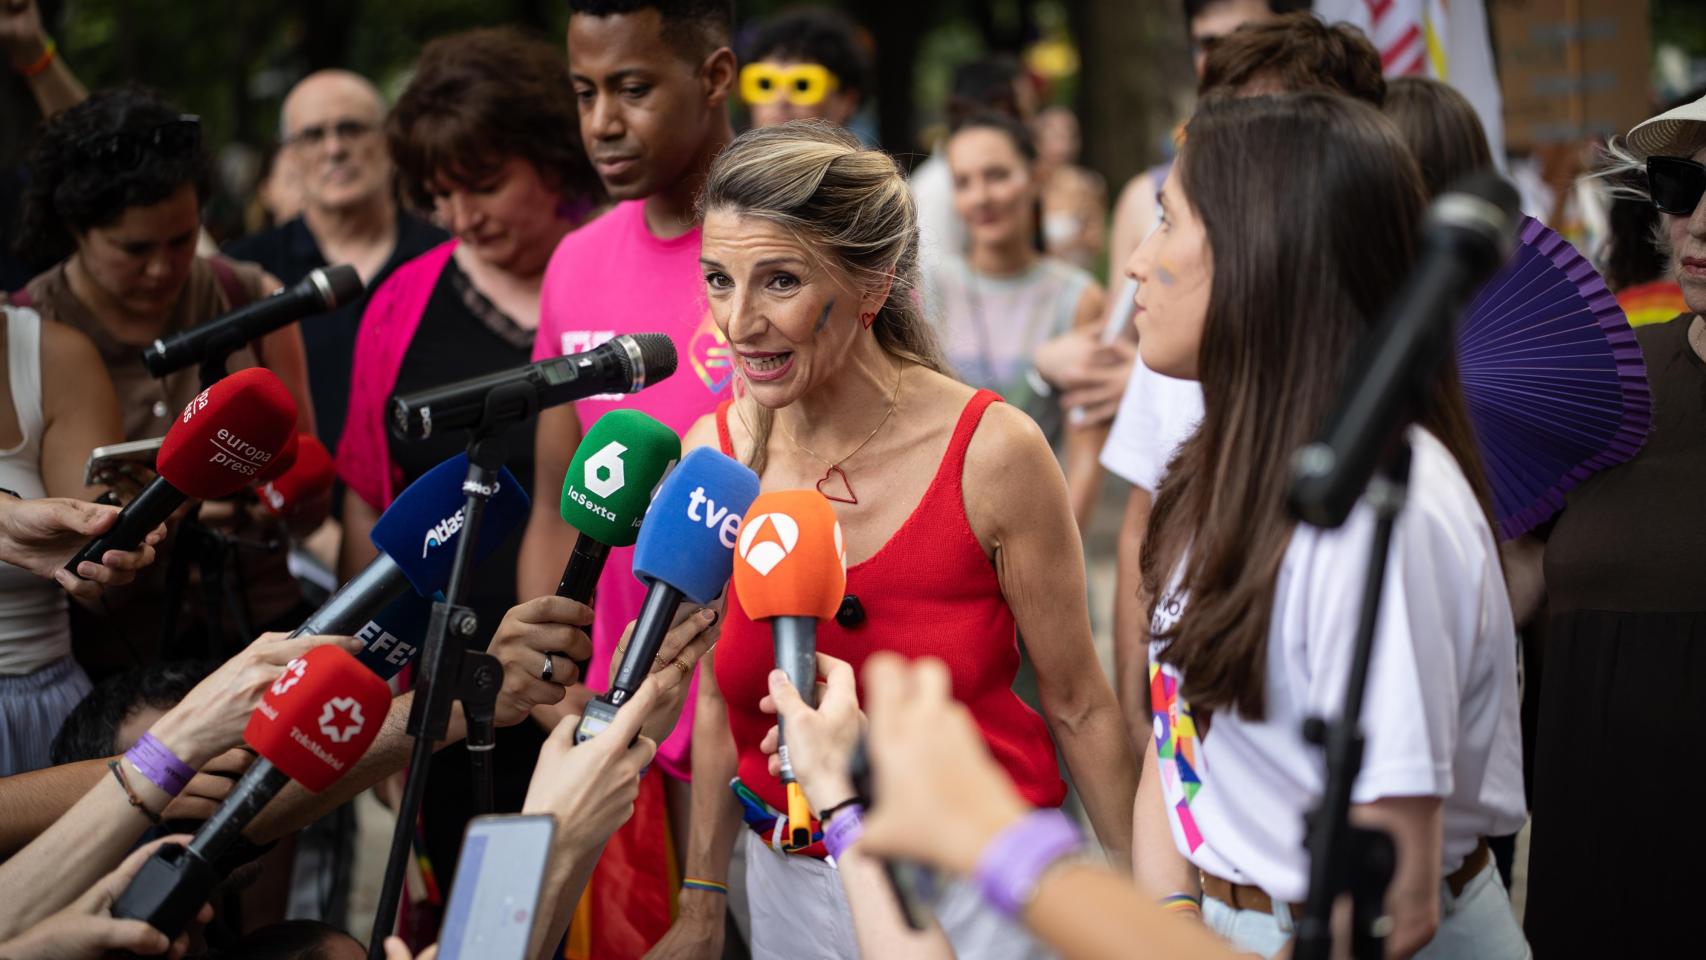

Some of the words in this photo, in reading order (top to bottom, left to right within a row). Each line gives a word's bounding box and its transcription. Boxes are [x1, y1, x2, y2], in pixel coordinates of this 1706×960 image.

[217, 428, 272, 462] europa
[209, 451, 257, 476] press
[568, 485, 617, 522] laSexta
[687, 486, 742, 549] tve
